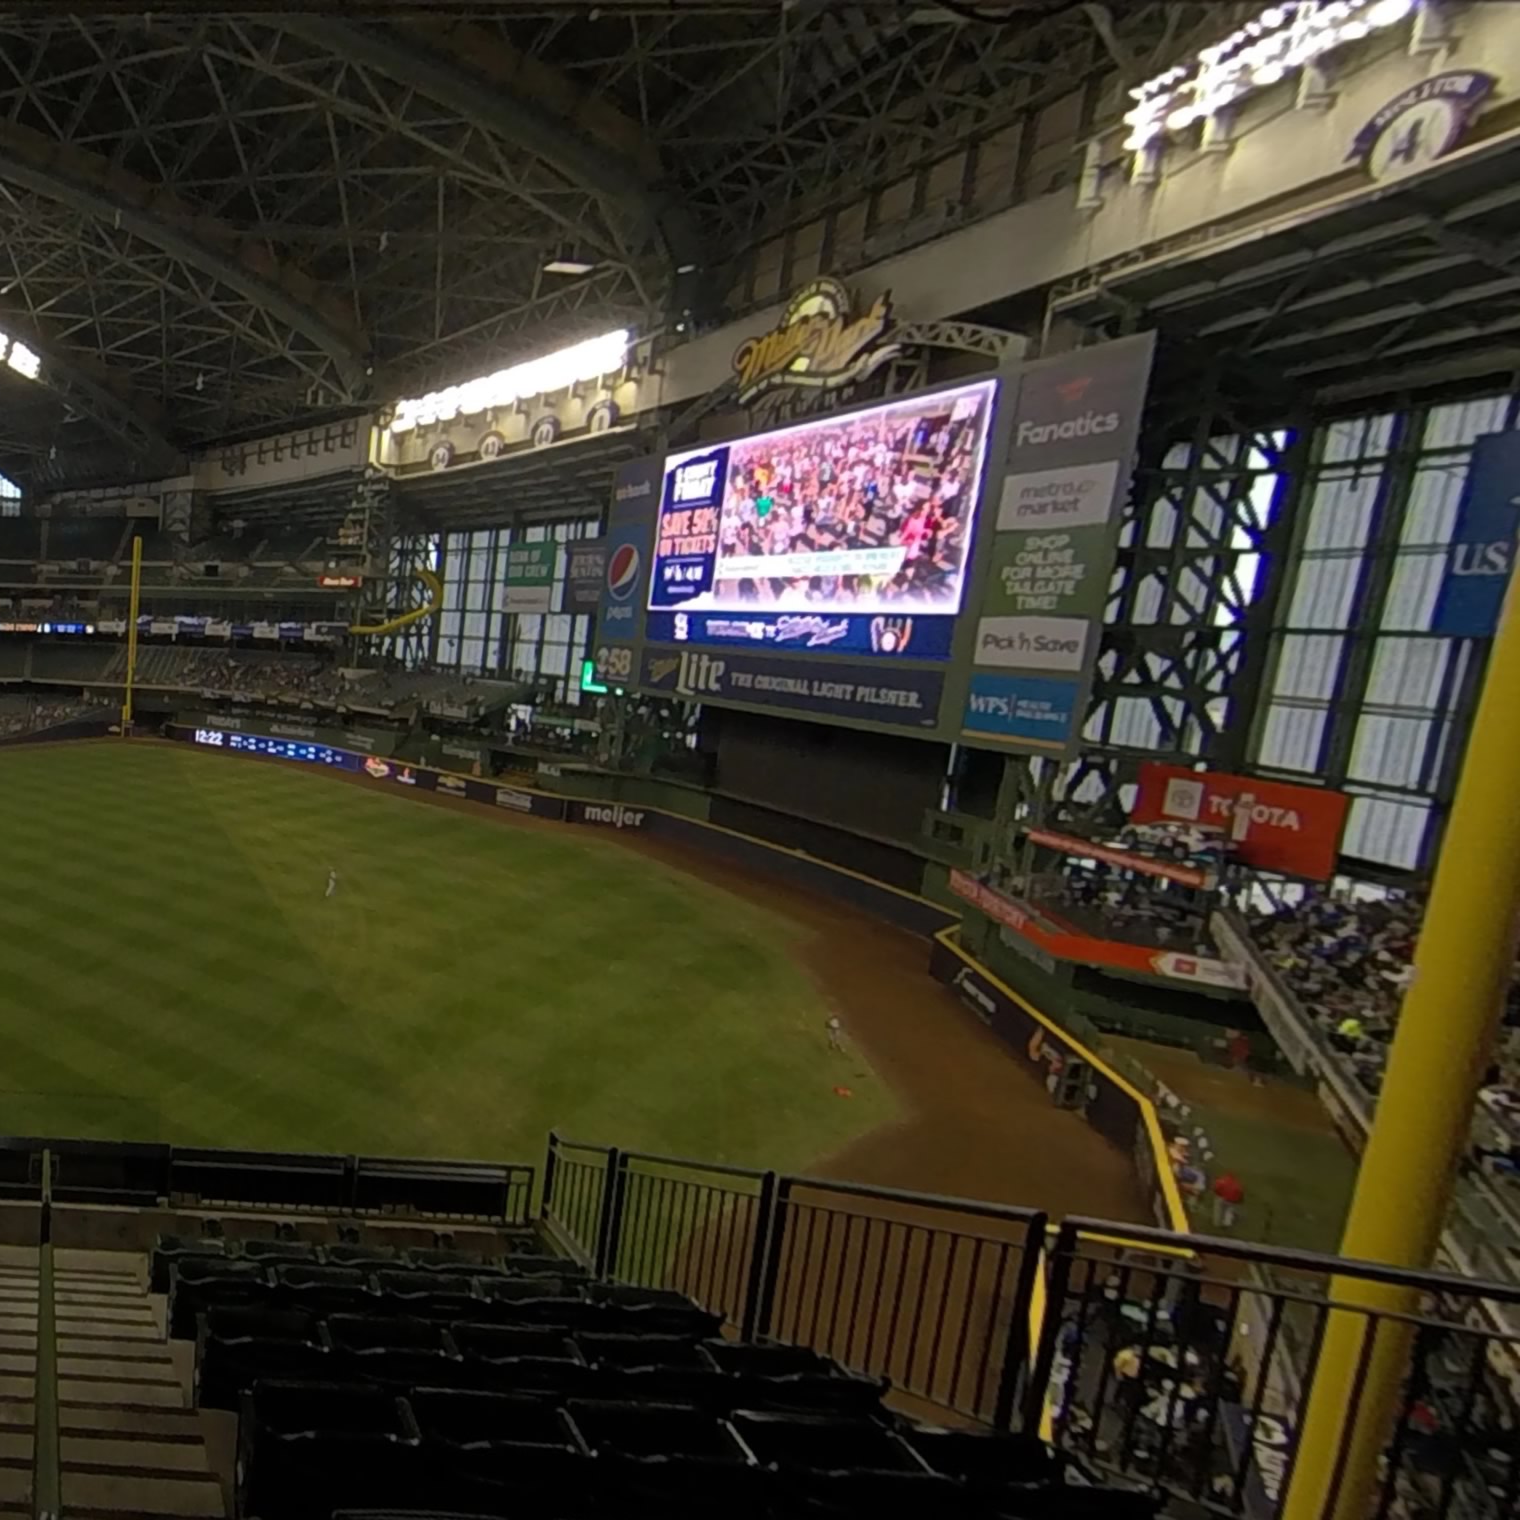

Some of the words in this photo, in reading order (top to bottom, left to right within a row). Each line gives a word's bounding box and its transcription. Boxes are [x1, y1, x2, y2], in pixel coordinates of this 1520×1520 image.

[1016, 411, 1120, 447] Fanatics
[1020, 481, 1075, 499] metro
[1017, 498, 1079, 516] market
[662, 511, 690, 537] SAVE
[1025, 534, 1071, 550] SHOP
[1016, 550, 1074, 565] ONLINE
[1001, 567, 1031, 581] FOR
[1036, 564, 1086, 580] MORE
[1005, 580, 1076, 595] TAILGATE
[983, 634, 1013, 651] Pick
[1034, 636, 1079, 653] Save
[675, 651, 725, 695] Lite
[731, 672, 752, 687] THE
[754, 674, 810, 694] ORIGINAL
[812, 680, 855, 700] LIGHT
[969, 694, 1010, 715] WPS
[195, 729, 224, 746] 12:22
[584, 805, 645, 828] meijer
